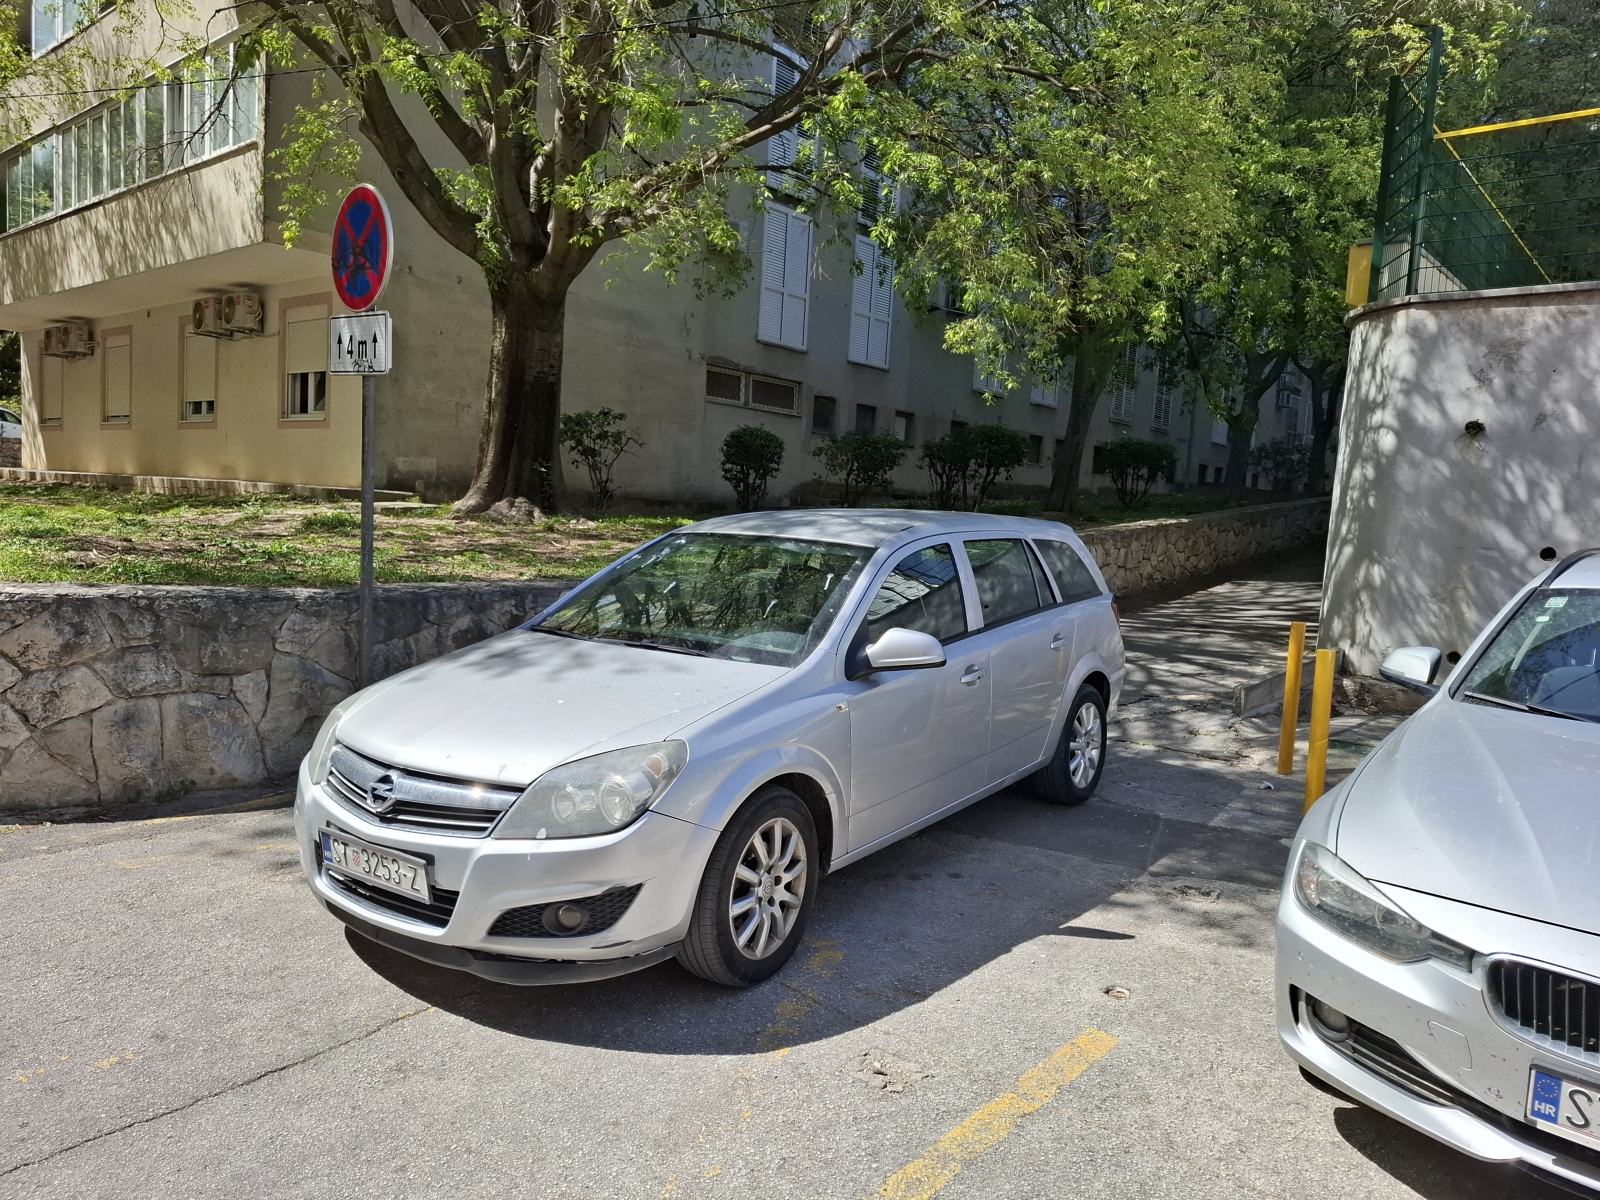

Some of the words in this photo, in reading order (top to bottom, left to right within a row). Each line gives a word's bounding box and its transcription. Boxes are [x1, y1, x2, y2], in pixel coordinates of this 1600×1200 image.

[346, 334, 354, 360] 4
[357, 339, 368, 360] m
[332, 838, 349, 867] ST
[1534, 1100, 1556, 1118] HR
[1565, 1089, 1600, 1129] S
